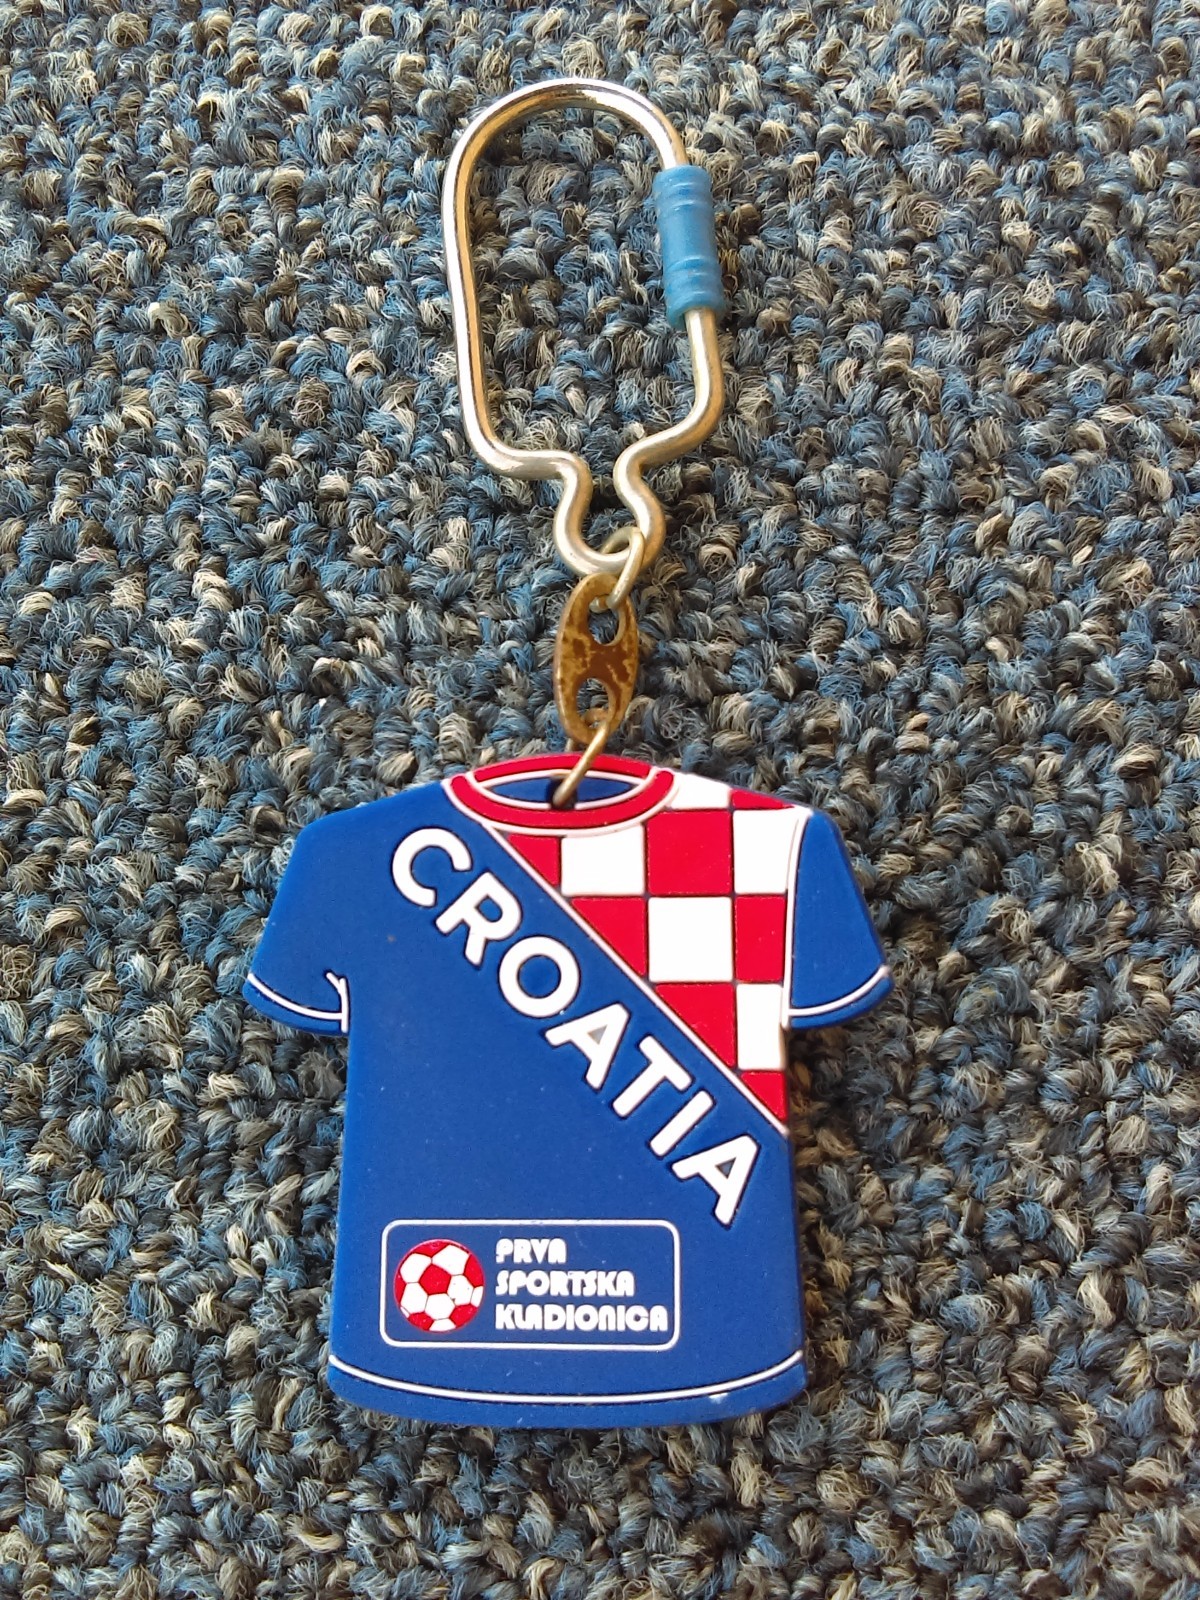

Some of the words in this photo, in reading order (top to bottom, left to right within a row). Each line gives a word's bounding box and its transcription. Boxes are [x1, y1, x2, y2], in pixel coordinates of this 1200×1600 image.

[392, 828, 760, 1226] CROATIA
[495, 1238, 568, 1264] PRVA
[495, 1270, 636, 1298] SPORTSKA
[495, 1303, 669, 1332] KLADIONICA
